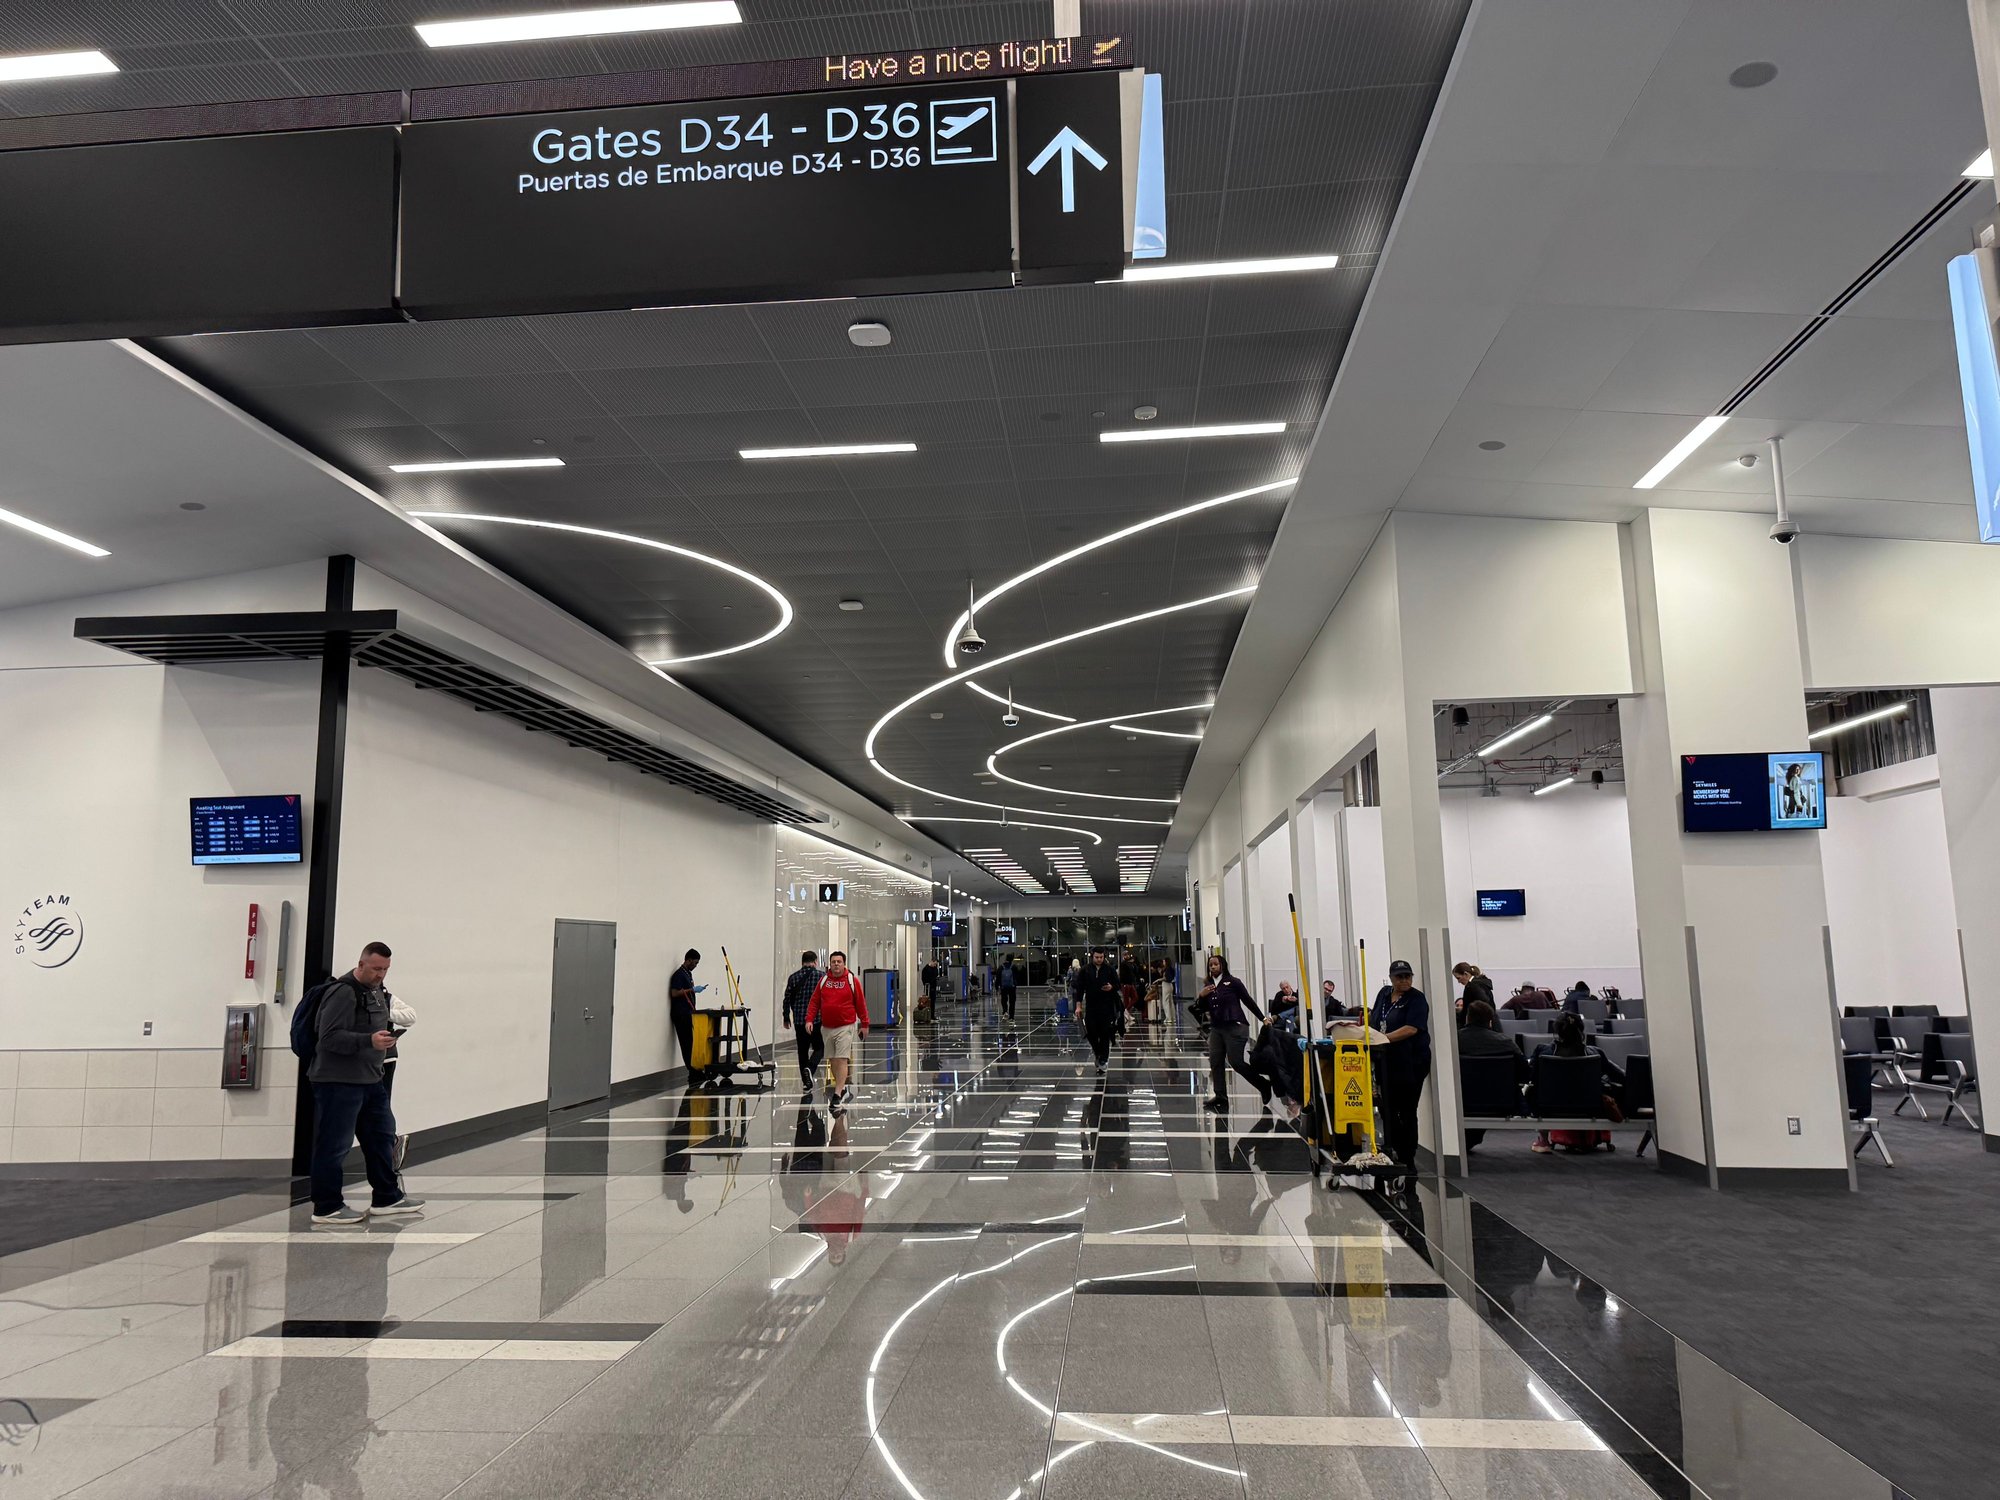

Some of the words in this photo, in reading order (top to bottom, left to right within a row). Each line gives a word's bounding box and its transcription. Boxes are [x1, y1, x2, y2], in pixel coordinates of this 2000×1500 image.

[825, 54, 898, 82] Have
[908, 56, 926, 76] a
[935, 46, 991, 73] nice
[999, 37, 1073, 71] flight!
[532, 126, 662, 164] Gates
[680, 112, 774, 154] D34
[791, 126, 807, 134] -
[826, 102, 920, 143] D36
[518, 171, 610, 194] Puertas
[617, 165, 649, 187] de
[656, 160, 784, 184] Embarque
[792, 151, 844, 175] D34
[870, 146, 921, 170] D36
[14, 894, 70, 955] SKYTEAM
